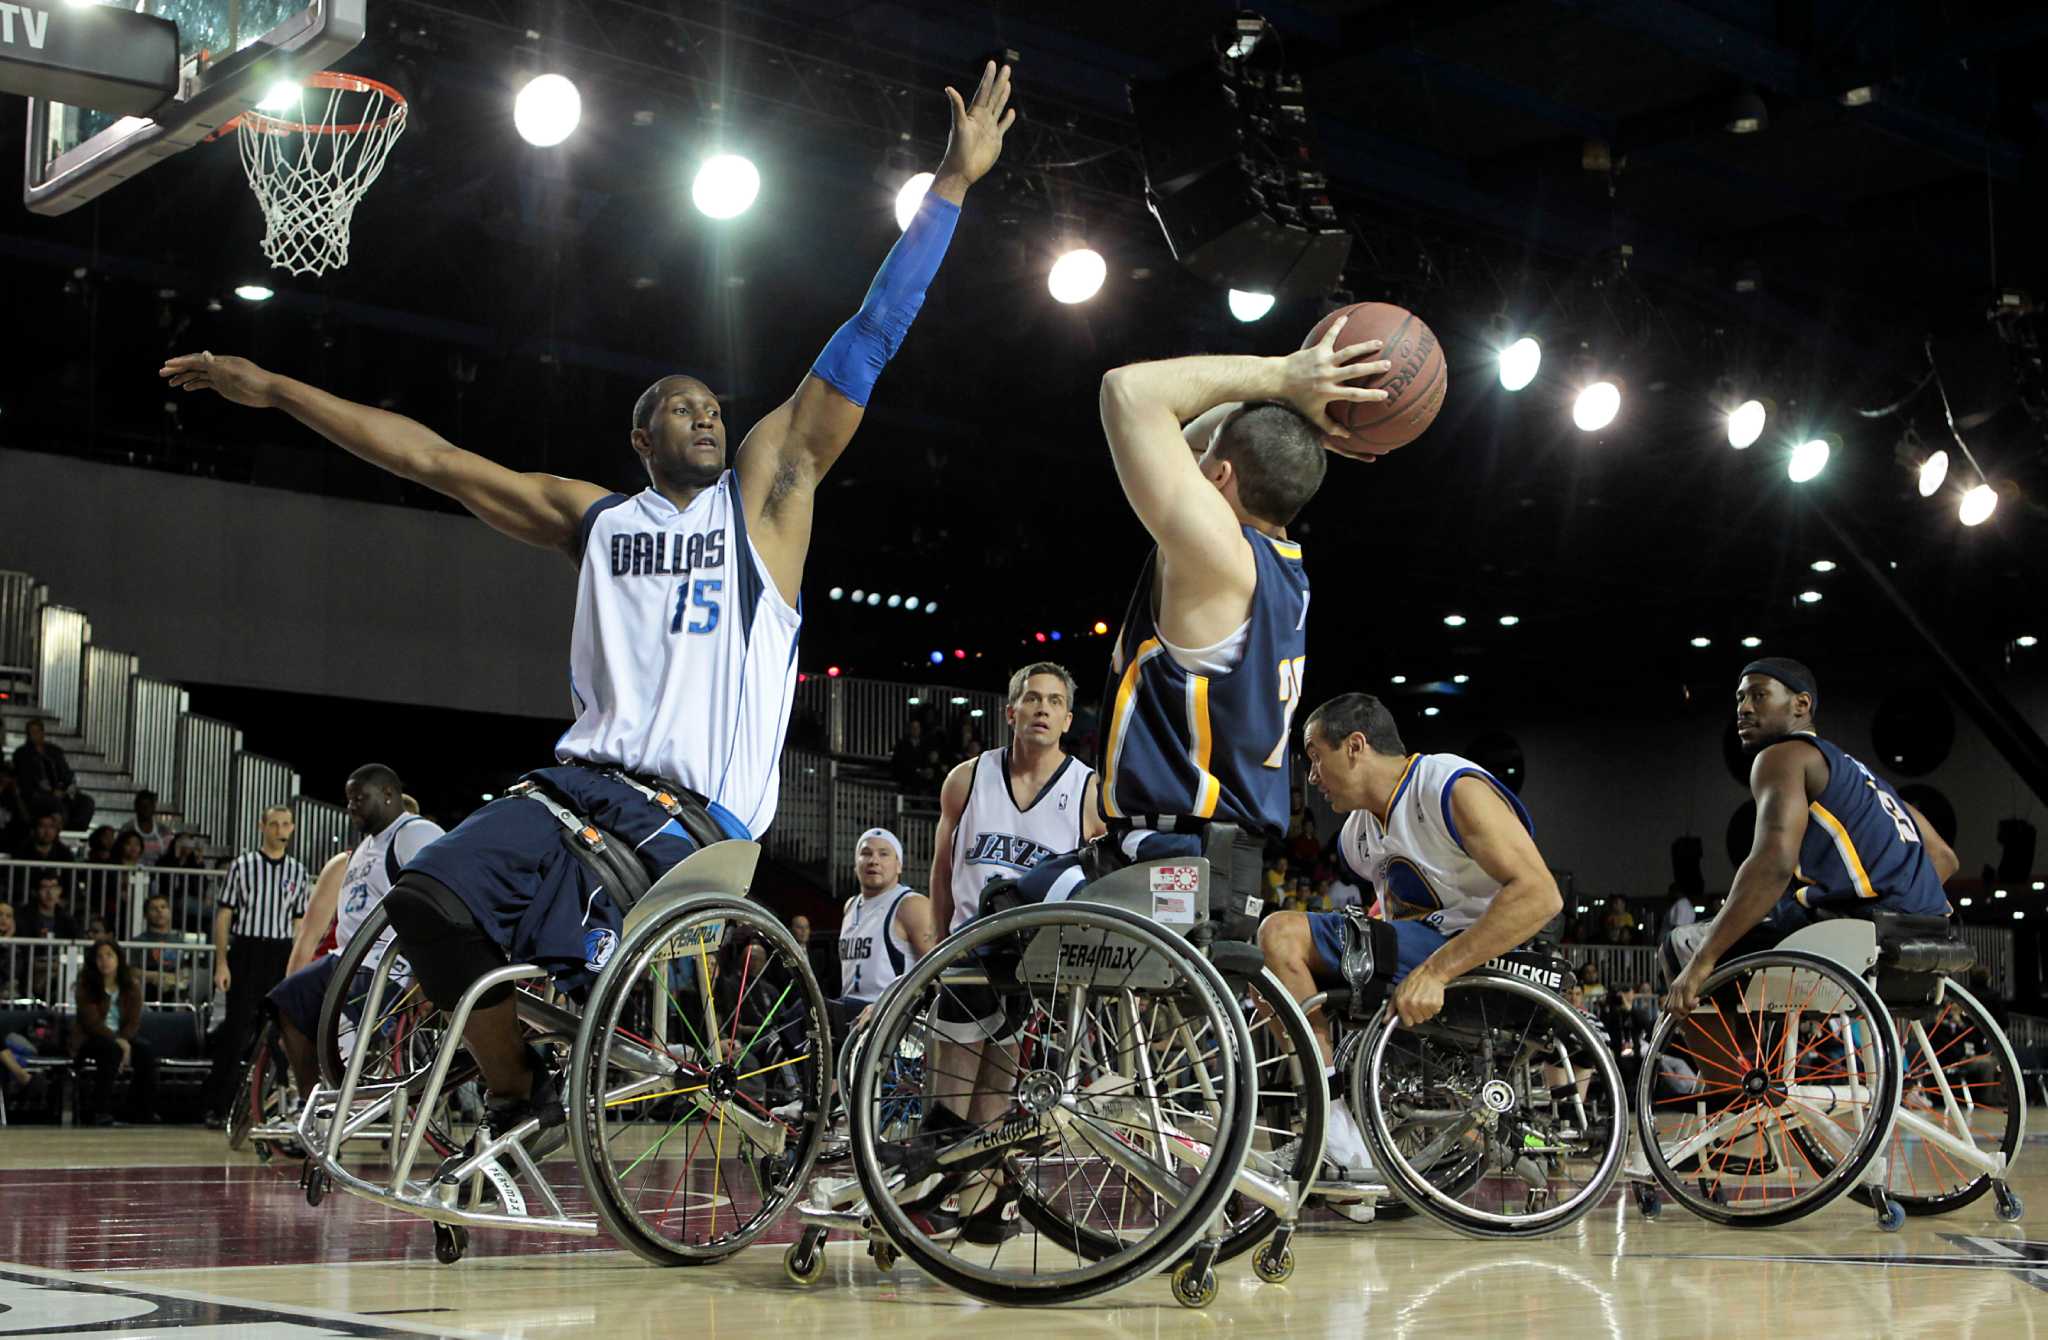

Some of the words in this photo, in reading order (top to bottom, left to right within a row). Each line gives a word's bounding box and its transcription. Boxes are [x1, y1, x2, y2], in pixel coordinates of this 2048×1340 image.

[0, 2, 48, 49] TV
[611, 529, 726, 576] DALLAS
[670, 578, 723, 636] 15
[1060, 944, 1137, 970] PER4MAX
